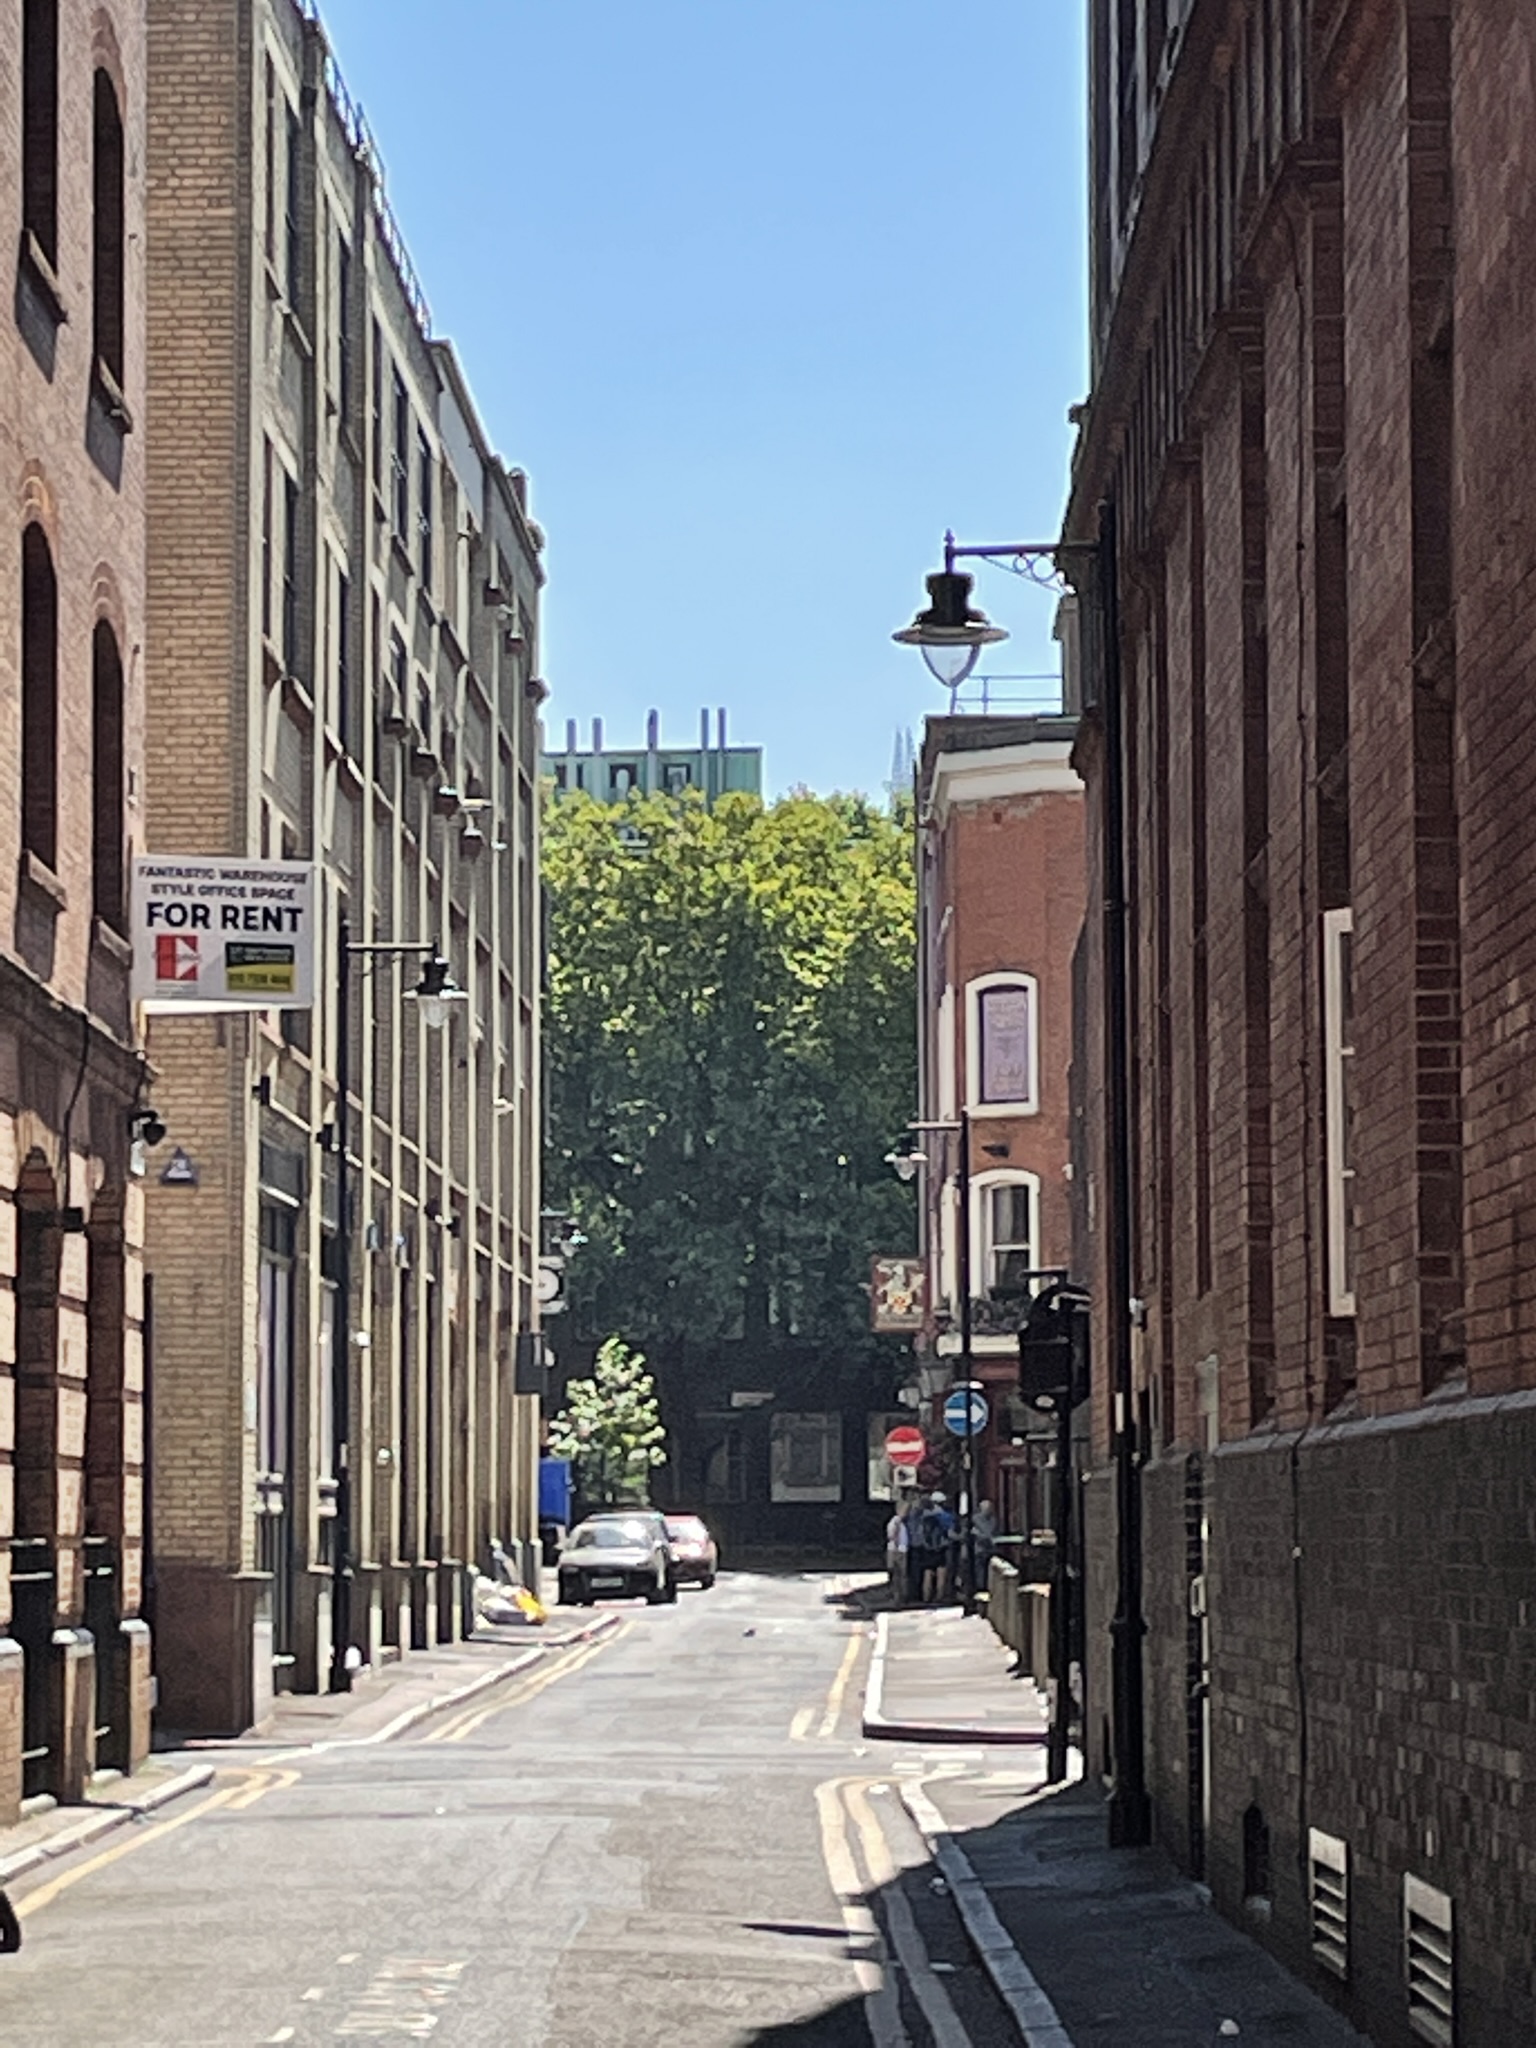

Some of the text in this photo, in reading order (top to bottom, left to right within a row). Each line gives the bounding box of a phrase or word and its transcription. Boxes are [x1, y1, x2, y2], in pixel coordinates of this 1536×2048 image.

[151, 884, 295, 900] STYLE OFFICE SPACE
[146, 902, 303, 932] FOR RENT
